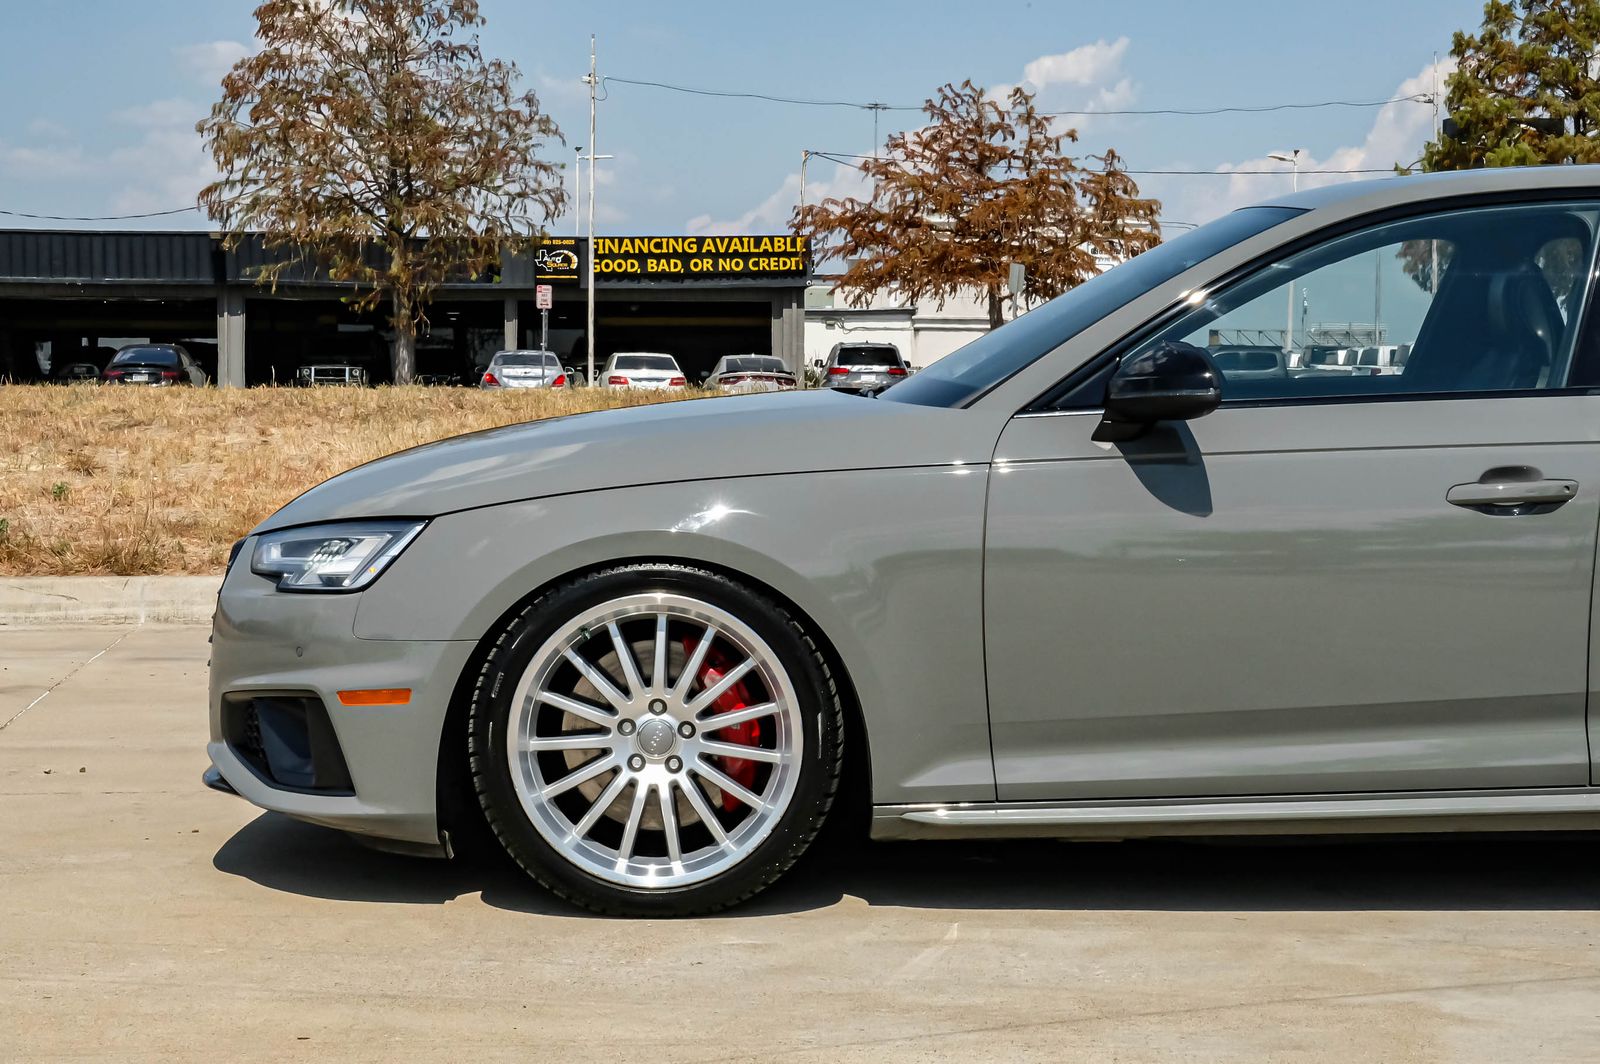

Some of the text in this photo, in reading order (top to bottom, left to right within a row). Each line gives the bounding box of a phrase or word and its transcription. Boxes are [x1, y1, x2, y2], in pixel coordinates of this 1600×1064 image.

[702, 237, 806, 253] AVAILABLE
[593, 259, 641, 274] GOOD,
[647, 258, 684, 274] BAD,
[689, 258, 714, 272] OR
[718, 258, 744, 272] NO
